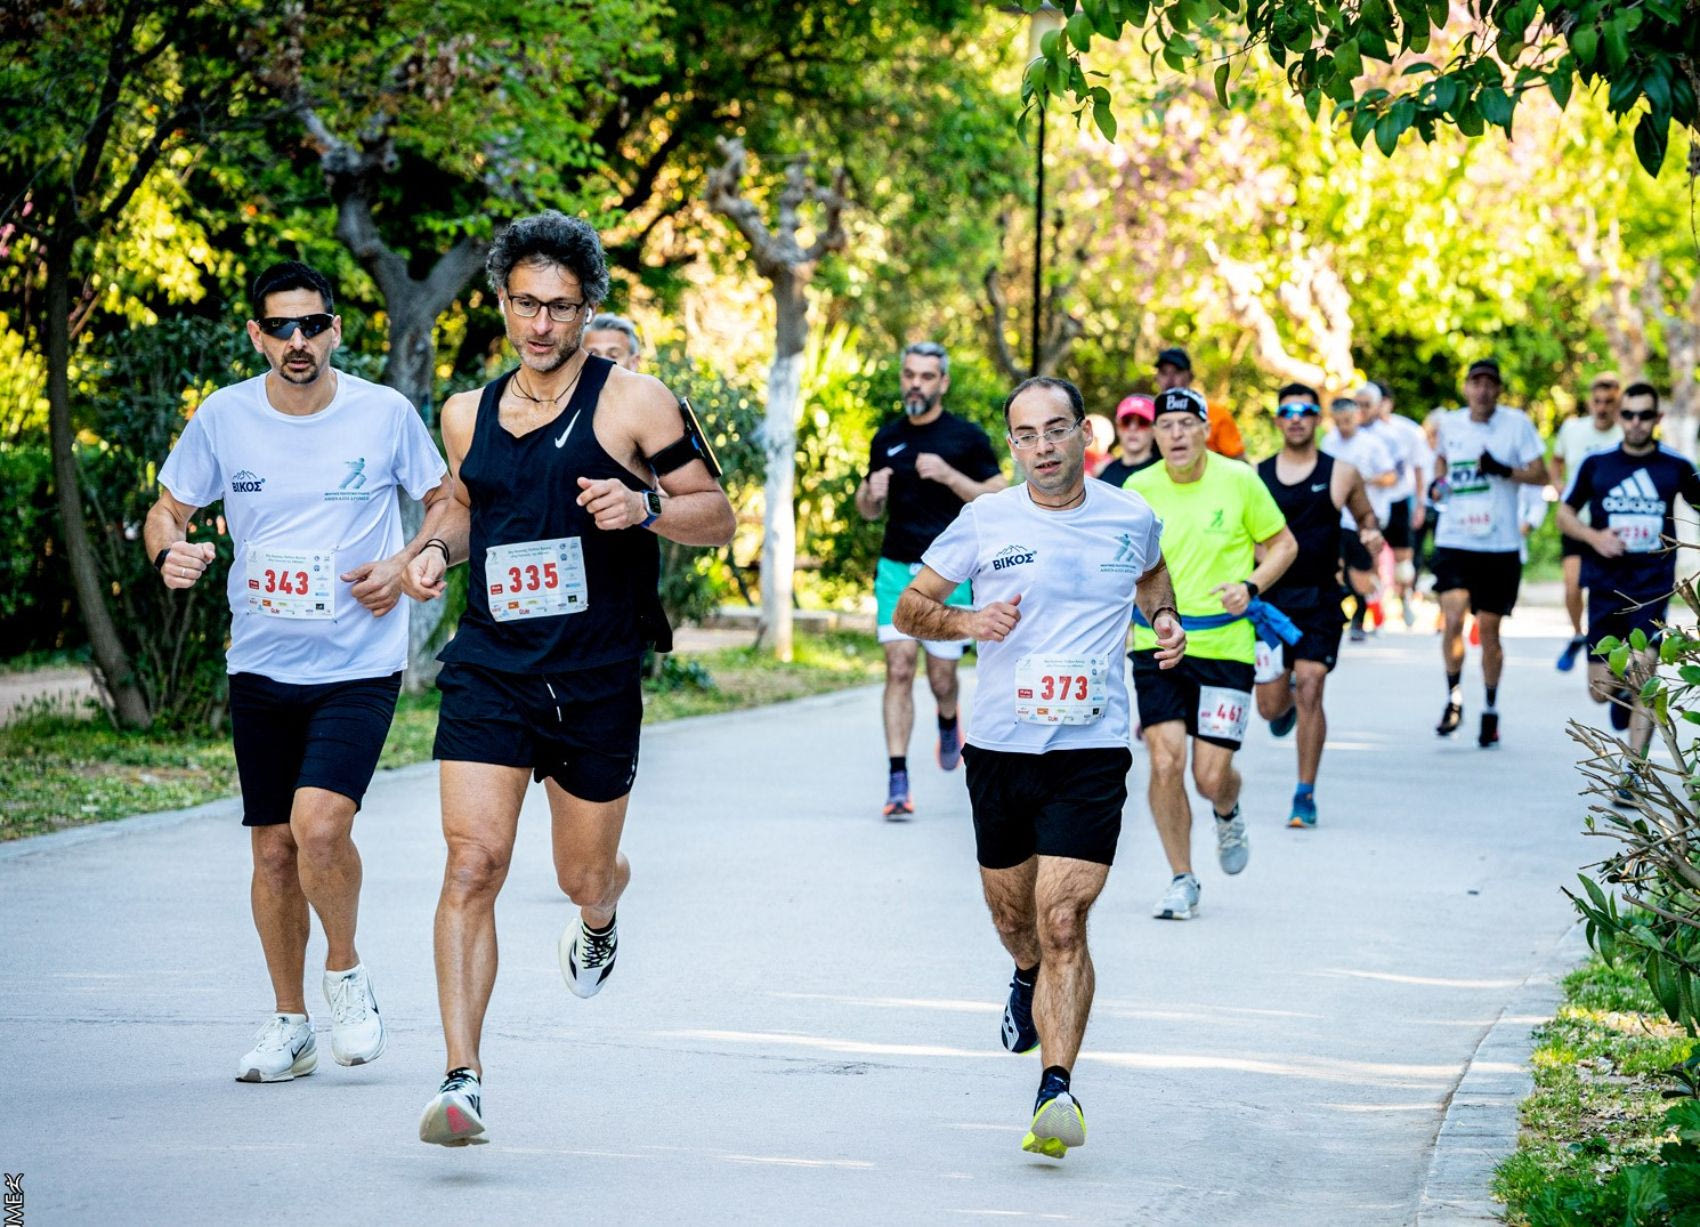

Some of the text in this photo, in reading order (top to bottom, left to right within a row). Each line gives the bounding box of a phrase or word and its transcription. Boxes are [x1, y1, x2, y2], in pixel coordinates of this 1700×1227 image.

[1602, 496, 1666, 515] adidas
[992, 553, 1035, 571] ΒΙΚΟΣ
[264, 568, 309, 596] 343
[508, 562, 558, 593] 335
[1041, 675, 1088, 701] 373
